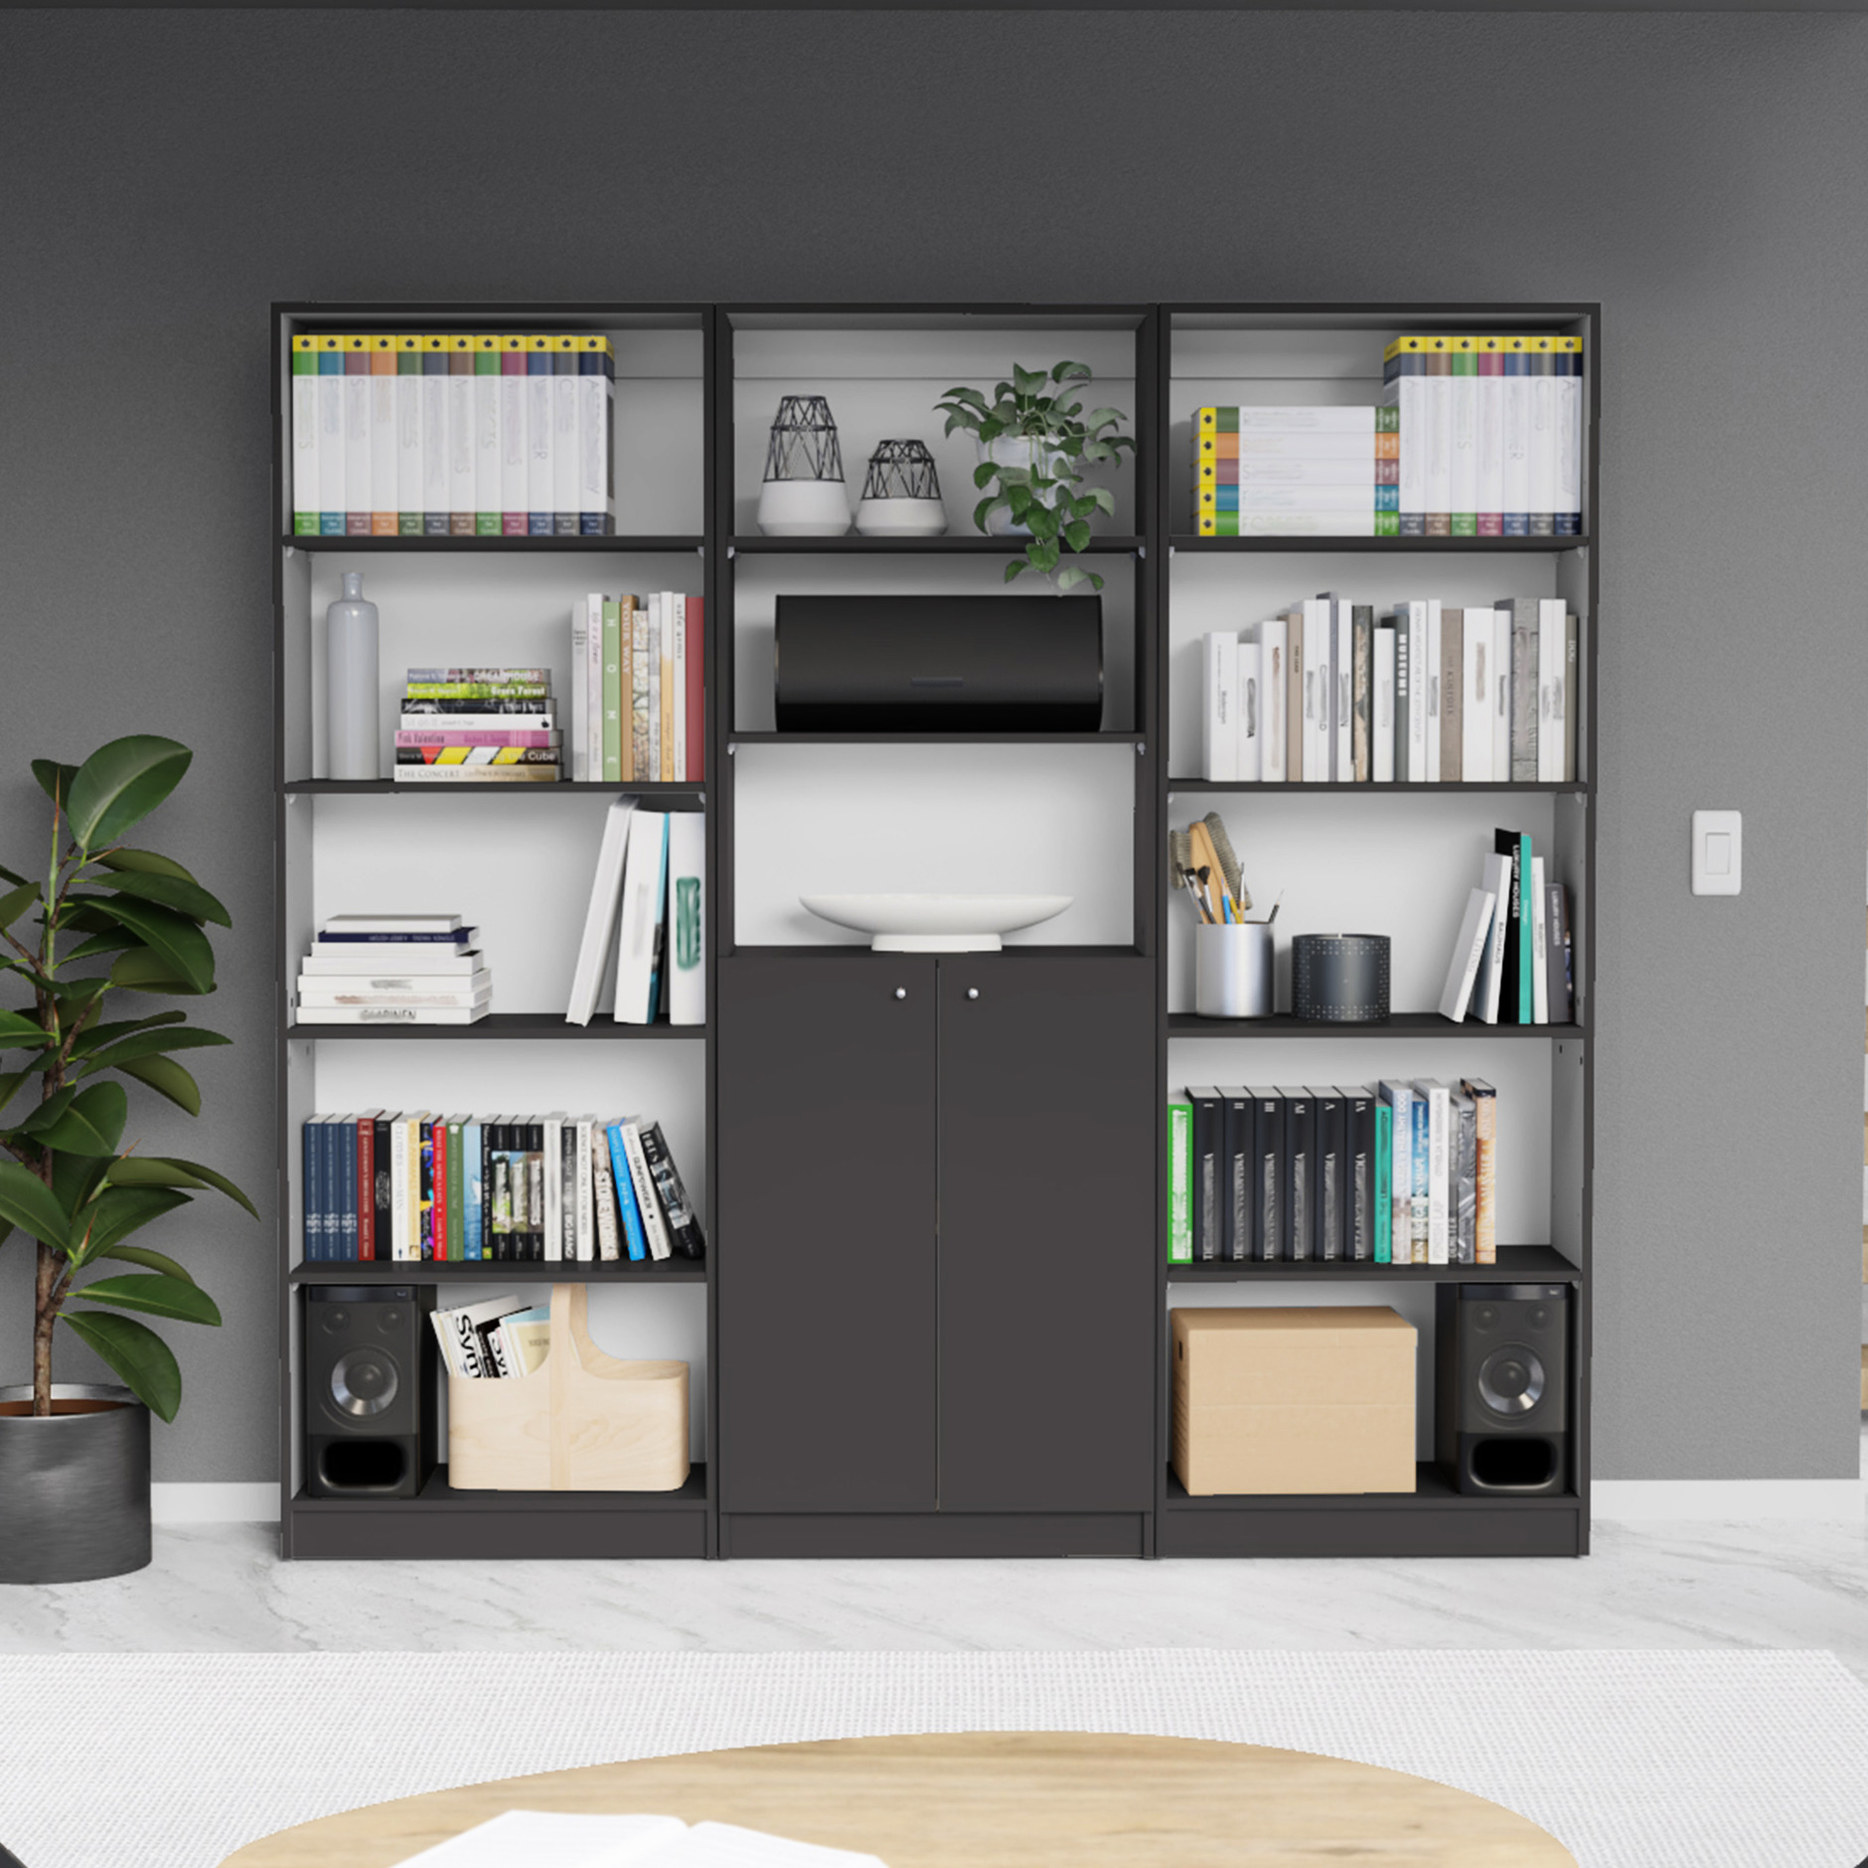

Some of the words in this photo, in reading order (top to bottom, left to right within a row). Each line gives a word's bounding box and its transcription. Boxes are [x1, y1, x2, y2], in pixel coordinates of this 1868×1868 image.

[622, 601, 630, 642] YOUR
[622, 645, 630, 675] WAY
[1398, 634, 1406, 697] MUSEUMS
[418, 768, 460, 778] CONCERT
[527, 751, 555, 761] Cube
[1512, 844, 1520, 879] LUXURY
[1512, 880, 1520, 918] HOUSES
[1552, 918, 1561, 946] HOUSES
[633, 1156, 652, 1210] GUNPOWDER
